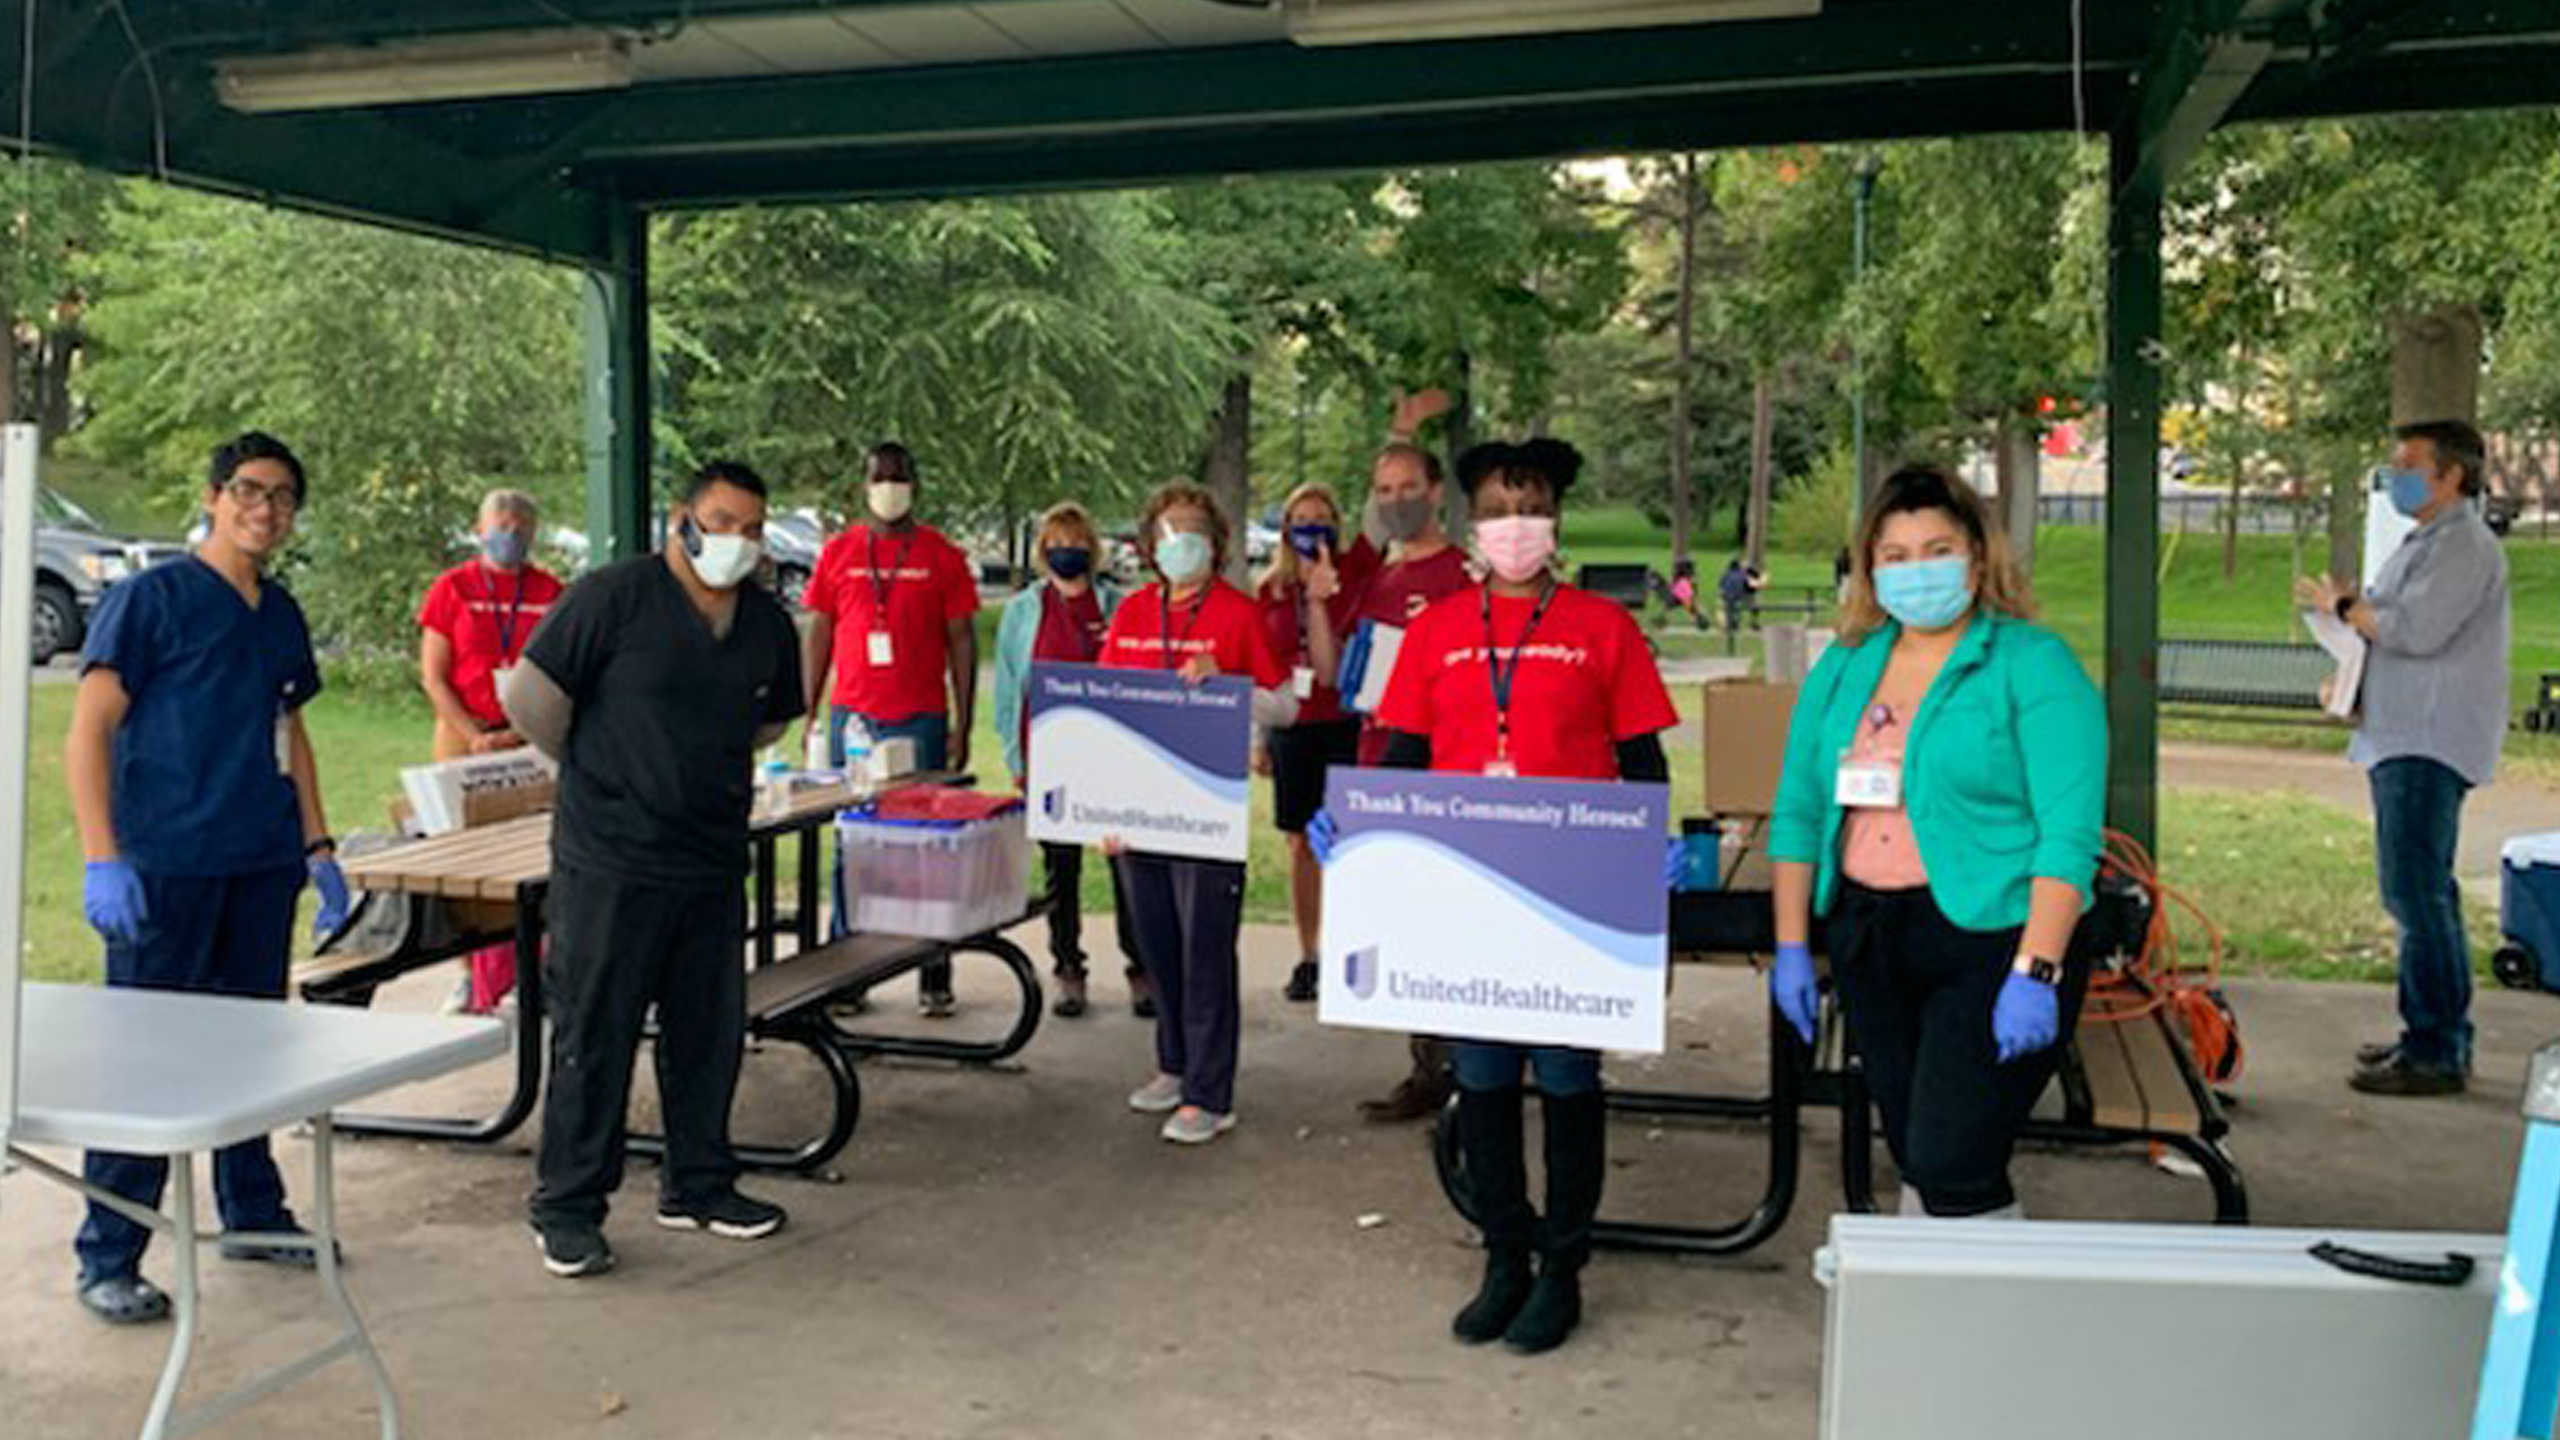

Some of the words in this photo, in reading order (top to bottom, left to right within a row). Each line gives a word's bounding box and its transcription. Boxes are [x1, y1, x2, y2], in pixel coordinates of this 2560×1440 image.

[1044, 677, 1083, 696] Thank
[1087, 680, 1109, 698] You
[1111, 682, 1185, 705] Community
[1072, 803, 1230, 837] UnitedHealthcare
[1346, 789, 1404, 814] Thank
[1409, 793, 1445, 818] You
[1449, 796, 1565, 828] Community
[1568, 802, 1648, 828] Heroes!
[1388, 970, 1635, 1018] UnitedHealthcare
